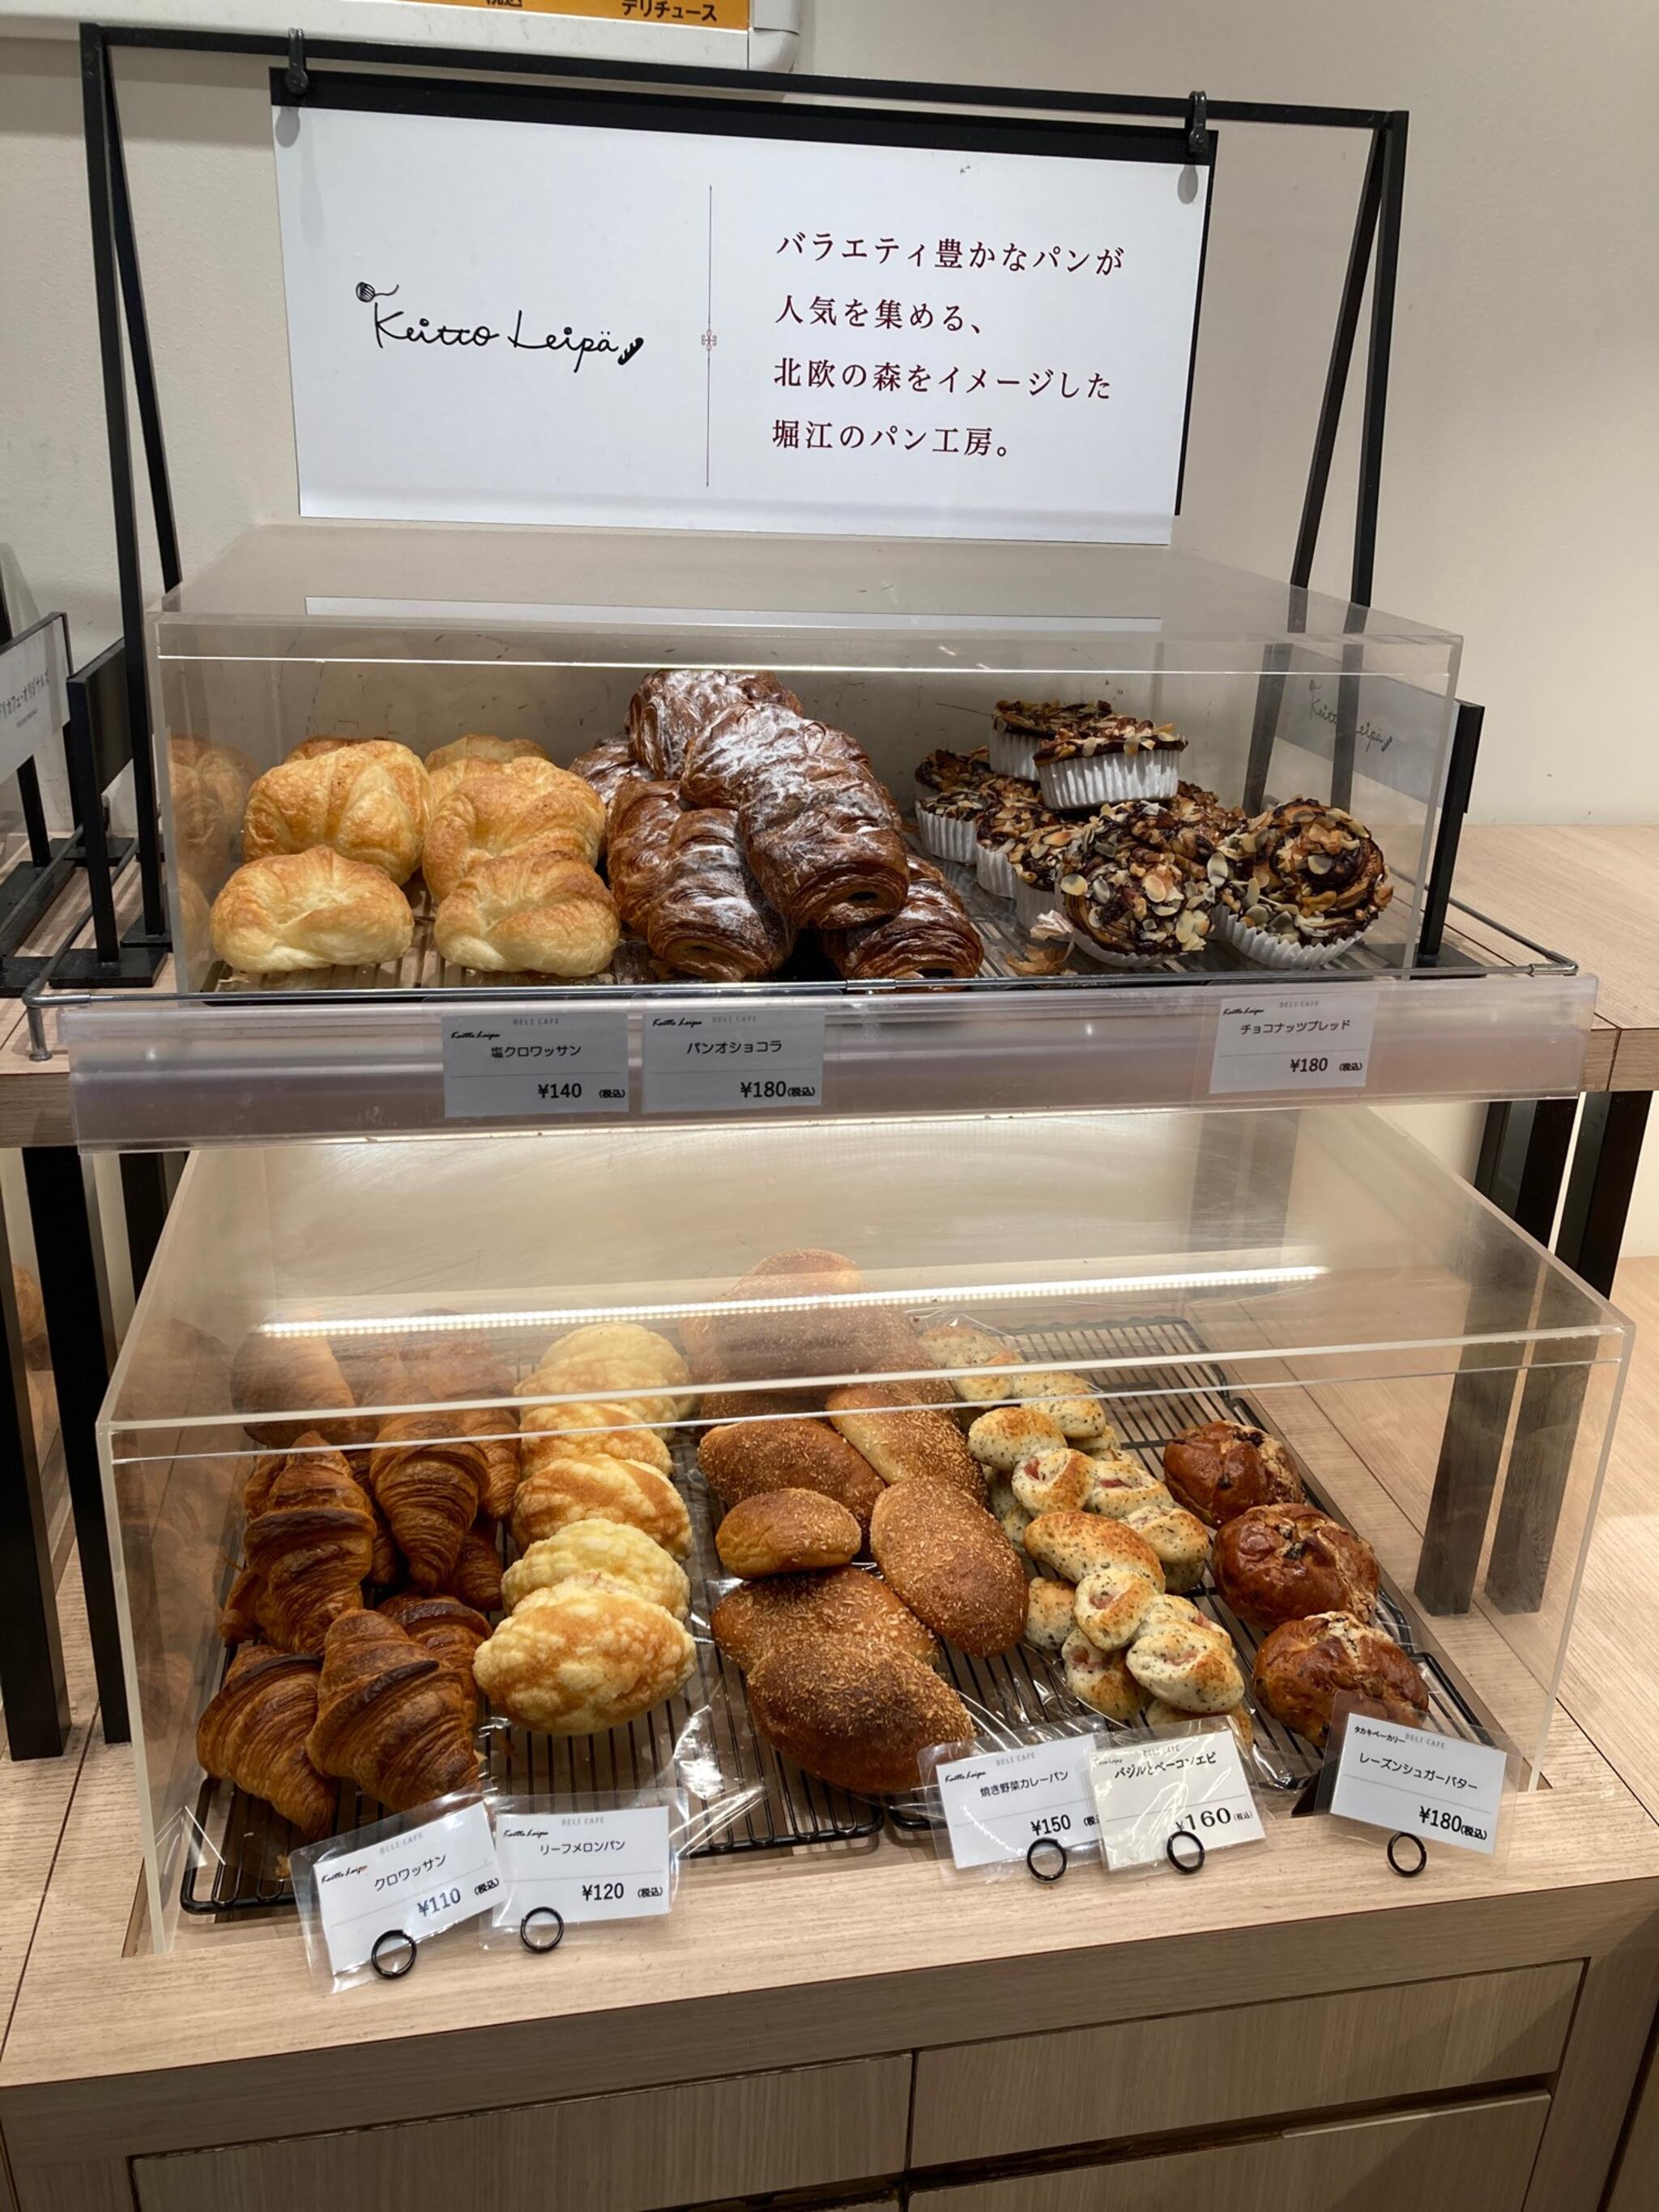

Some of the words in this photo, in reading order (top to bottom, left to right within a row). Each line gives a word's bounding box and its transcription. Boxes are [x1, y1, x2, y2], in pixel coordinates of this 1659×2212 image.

[776, 232, 1124, 275] バラエティ豊かなパンが
[775, 295, 981, 334] 人気を集める、
[373, 302, 499, 348] Keitto
[508, 310, 619, 373] Leipä
[774, 357, 1111, 400] 北欧の森をイメージした
[772, 420, 1008, 457] 堀江のパン工房。
[1240, 1020, 1350, 1035] チョコナッツブレッド
[491, 1045, 581, 1058] 塩クロワッサン
[1290, 1058, 1328, 1072] ¥180
[538, 1083, 582, 1098] ¥140
[740, 1080, 787, 1097] ¥180
[980, 1771, 1068, 1798] 焼き野菜カレーパン
[1359, 1752, 1478, 1790] レーズンシュガーバター
[1030, 1814, 1072, 1836] ¥150
[1419, 1805, 1462, 1832] ¥180
[540, 1840, 625, 1855] リーフメロンパン
[374, 1855, 446, 1891] クロワッサン
[417, 1888, 462, 1917] ¥110
[582, 1882, 625, 1901] ¥120
